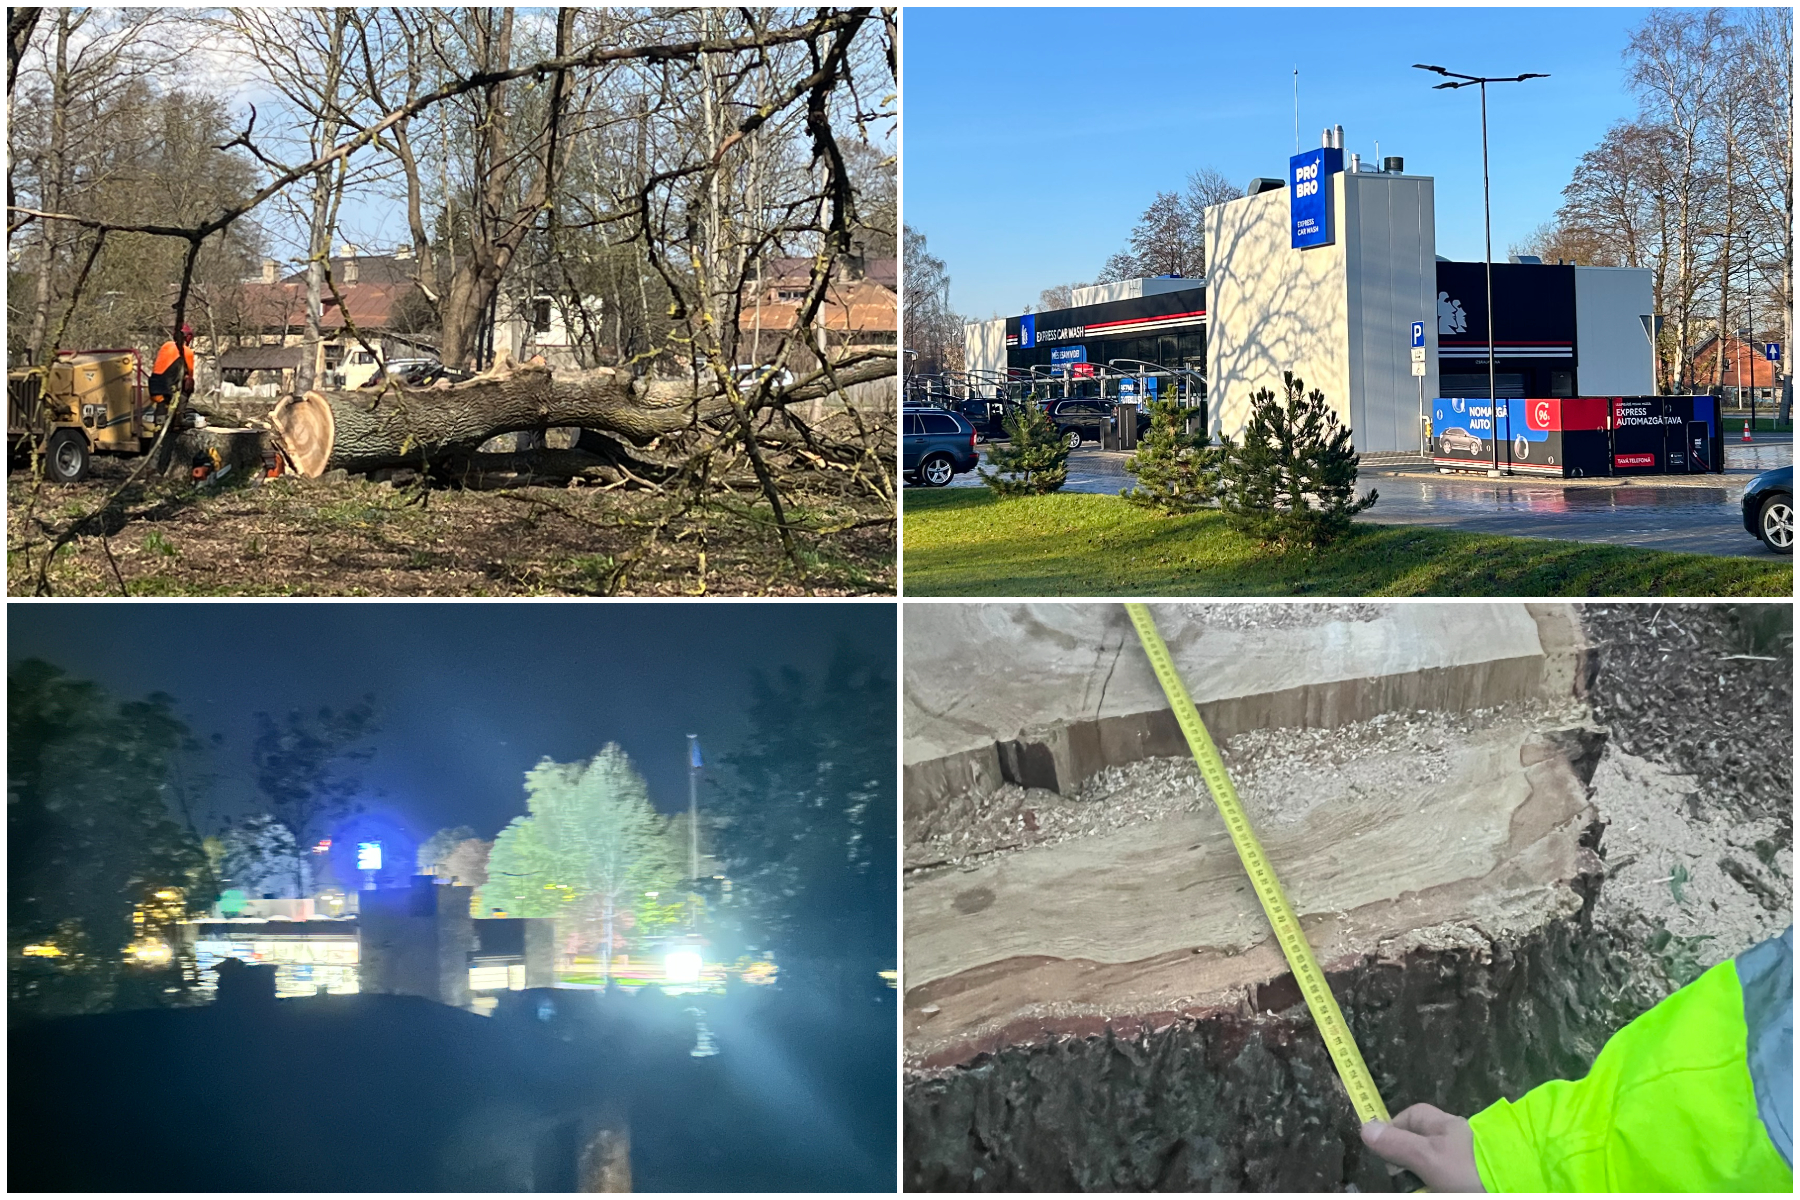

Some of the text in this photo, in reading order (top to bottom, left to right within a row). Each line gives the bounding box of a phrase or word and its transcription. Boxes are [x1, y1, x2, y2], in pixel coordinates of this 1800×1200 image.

[1296, 164, 1318, 182] PRO
[1296, 180, 1318, 198] BRO
[1298, 218, 1314, 228] EXPRESS
[1298, 226, 1319, 236] CAR WASH
[1036, 326, 1084, 342] EXPRESS CAR WASH
[1414, 324, 1421, 344] P
[1616, 408, 1647, 417] EXPRESS
[1470, 419, 1490, 429] AUTO
[1364, 1103, 1374, 1112] 117
